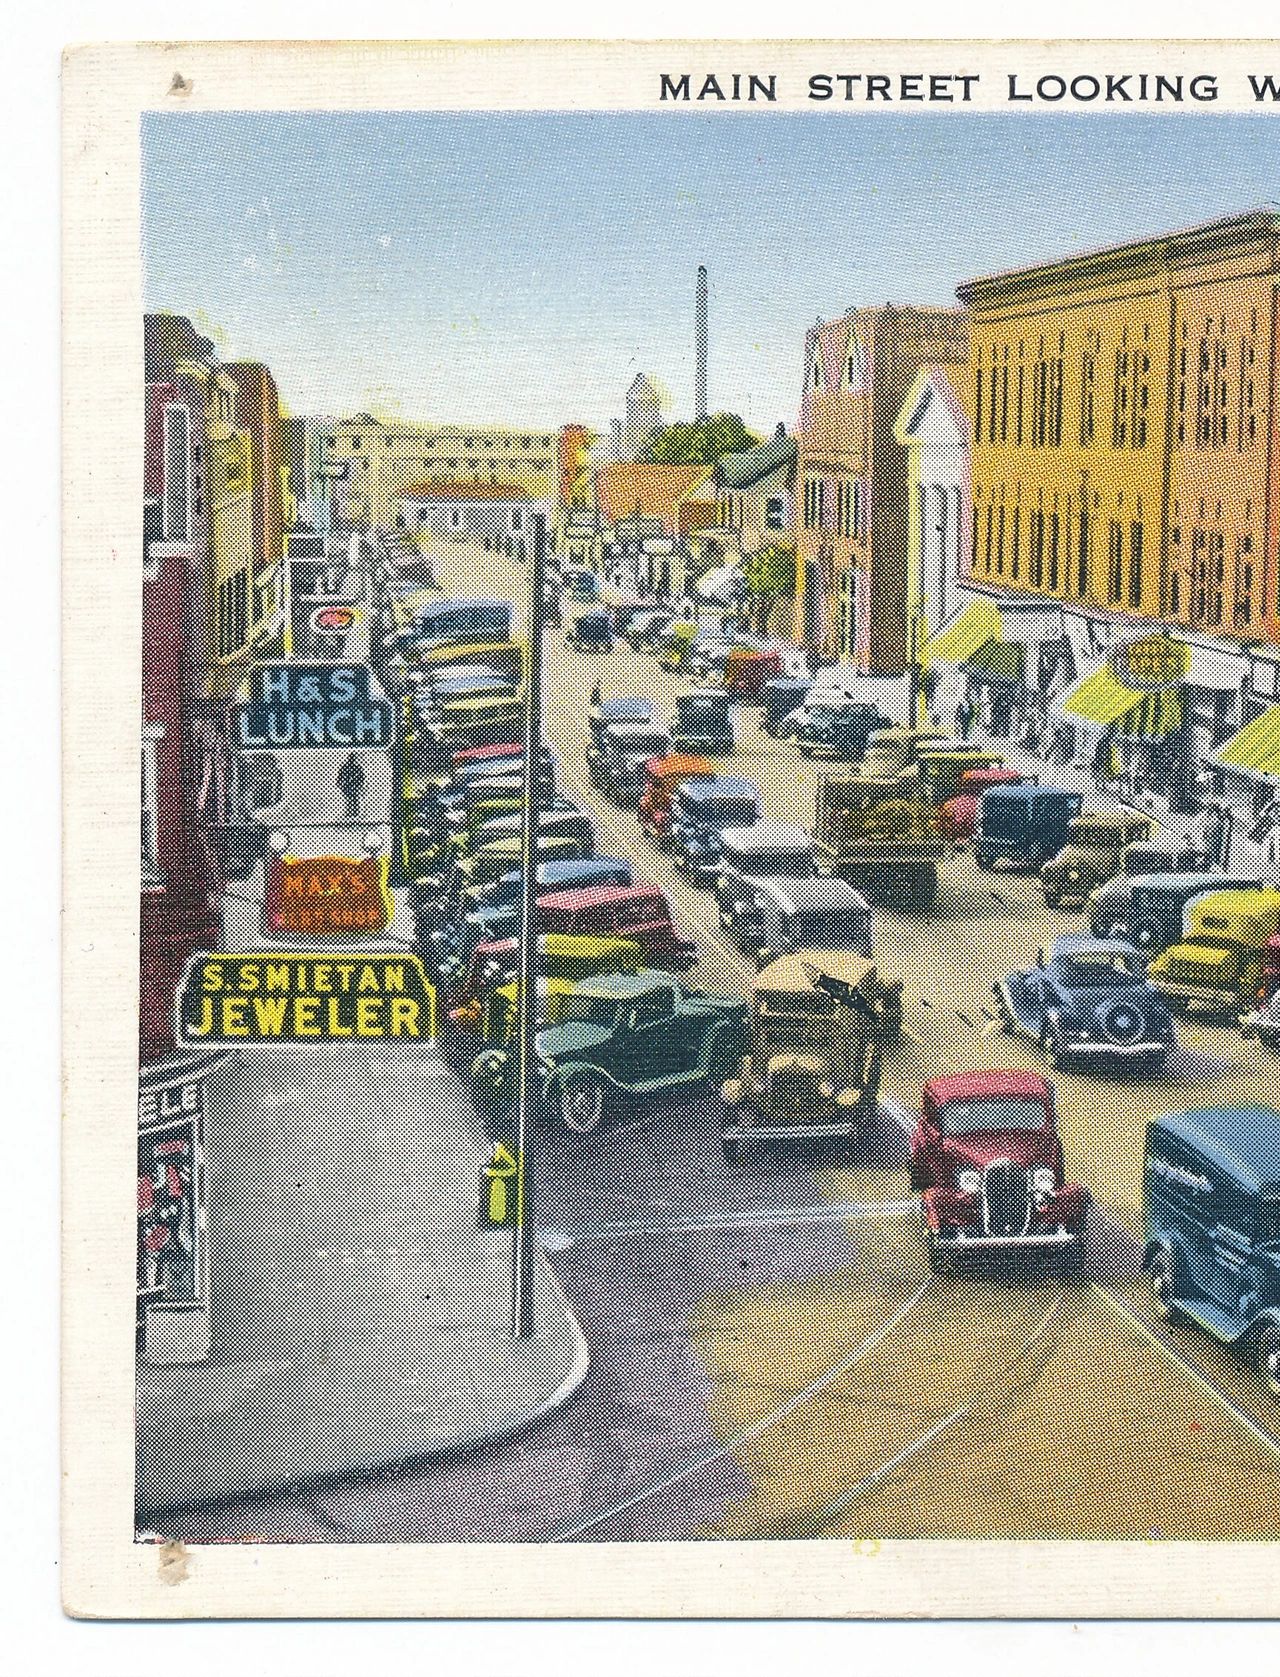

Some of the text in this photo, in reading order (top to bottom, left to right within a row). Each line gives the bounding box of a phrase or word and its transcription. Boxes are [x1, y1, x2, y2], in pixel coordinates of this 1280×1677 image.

[240, 709, 382, 744] LUNCH
[331, 908, 379, 926] SHOP
[187, 998, 420, 1036] JEWELER
